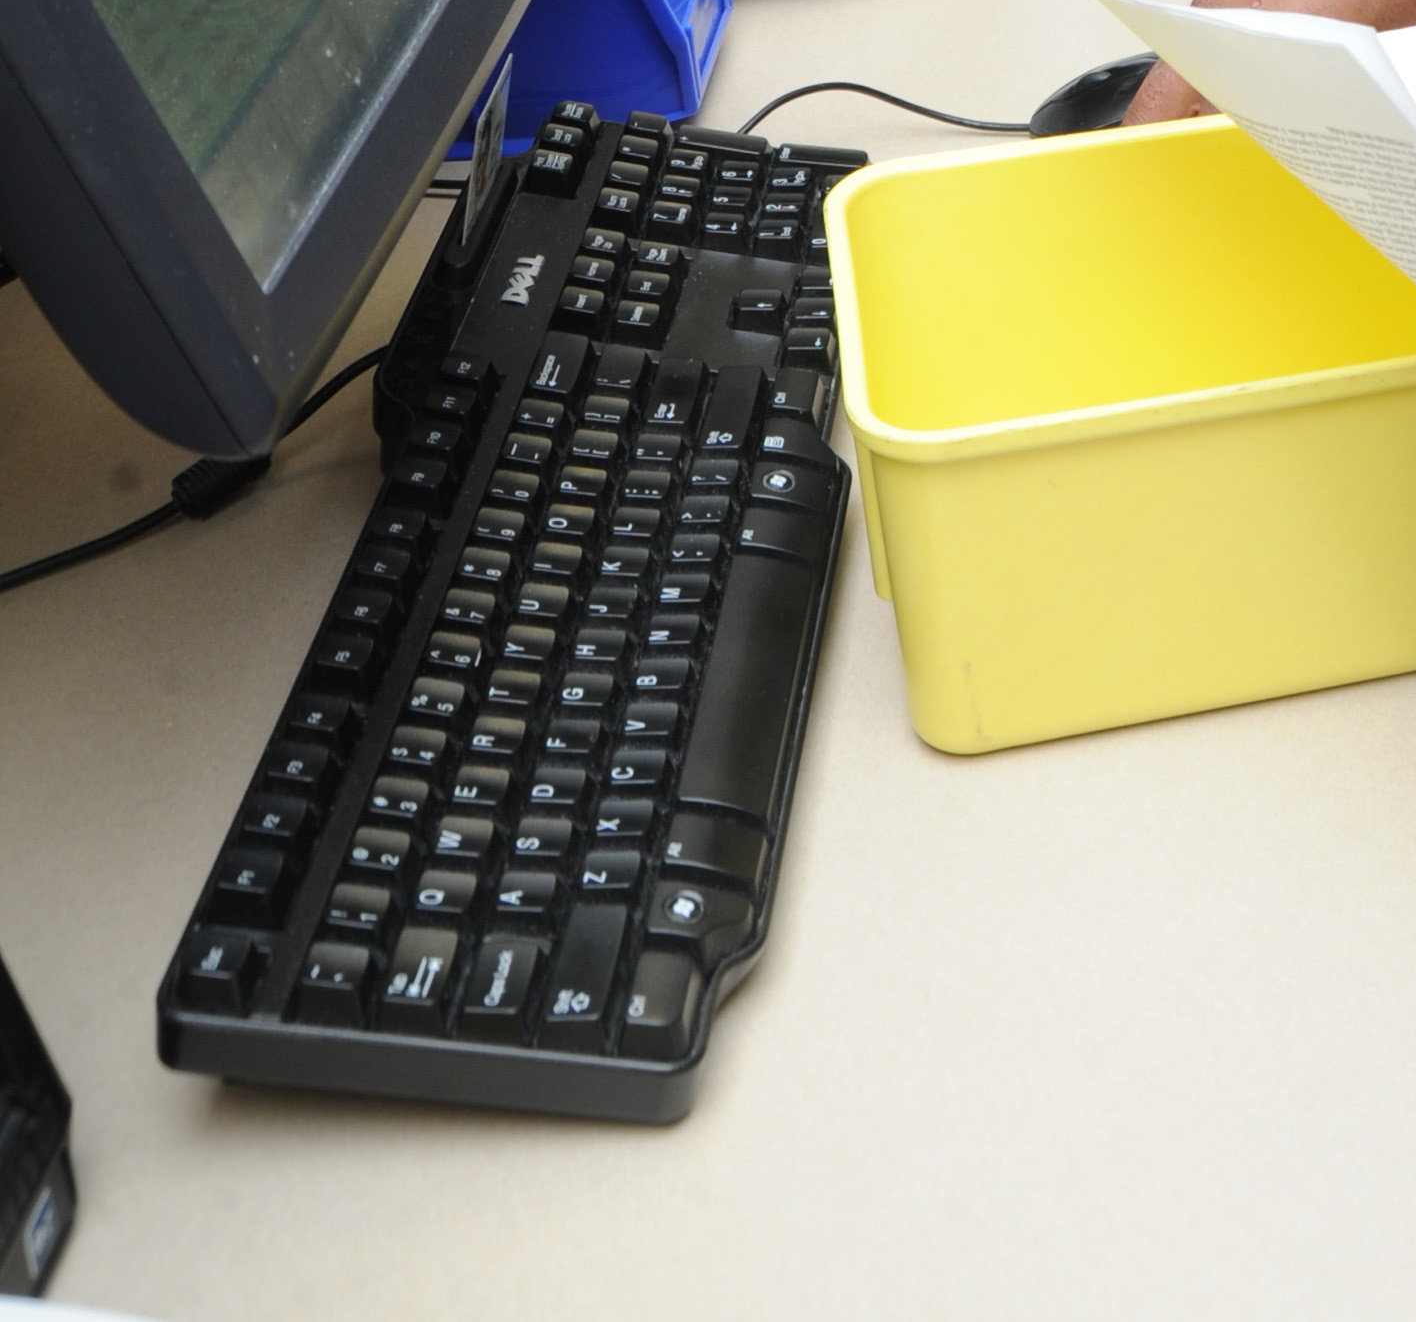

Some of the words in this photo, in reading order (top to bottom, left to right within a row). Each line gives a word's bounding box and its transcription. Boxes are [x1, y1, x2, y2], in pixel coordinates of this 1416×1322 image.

[501, 254, 545, 306] DELL
[457, 361, 471, 374] F12
[536, 354, 556, 386] Backspace
[441, 396, 456, 409] F11
[426, 431, 441, 445] F10
[411, 472, 425, 482] F9
[560, 481, 577, 490] P
[548, 517, 568, 528] O
[613, 523, 632, 532] L
[373, 561, 388, 573] F7
[601, 560, 621, 572] K
[660, 587, 680, 599] M
[519, 599, 539, 611] U
[588, 603, 608, 614] J
[649, 630, 669, 641] N
[504, 641, 525, 654] Y
[575, 644, 596, 656] H
[636, 674, 657, 686] B
[489, 686, 509, 698] T
[562, 687, 584, 700] G
[437, 702, 455, 713] 5
[624, 719, 646, 732] V
[472, 734, 495, 747] R
[546, 737, 567, 748] F
[610, 766, 635, 780] C
[455, 785, 479, 798] E
[532, 784, 555, 798] D
[400, 800, 419, 812] 3
[596, 818, 620, 832] X
[436, 829, 463, 849] W
[516, 836, 540, 850] S
[380, 853, 400, 866] 2
[583, 870, 607, 885] Z
[418, 888, 446, 906] Q
[499, 890, 524, 906] A
